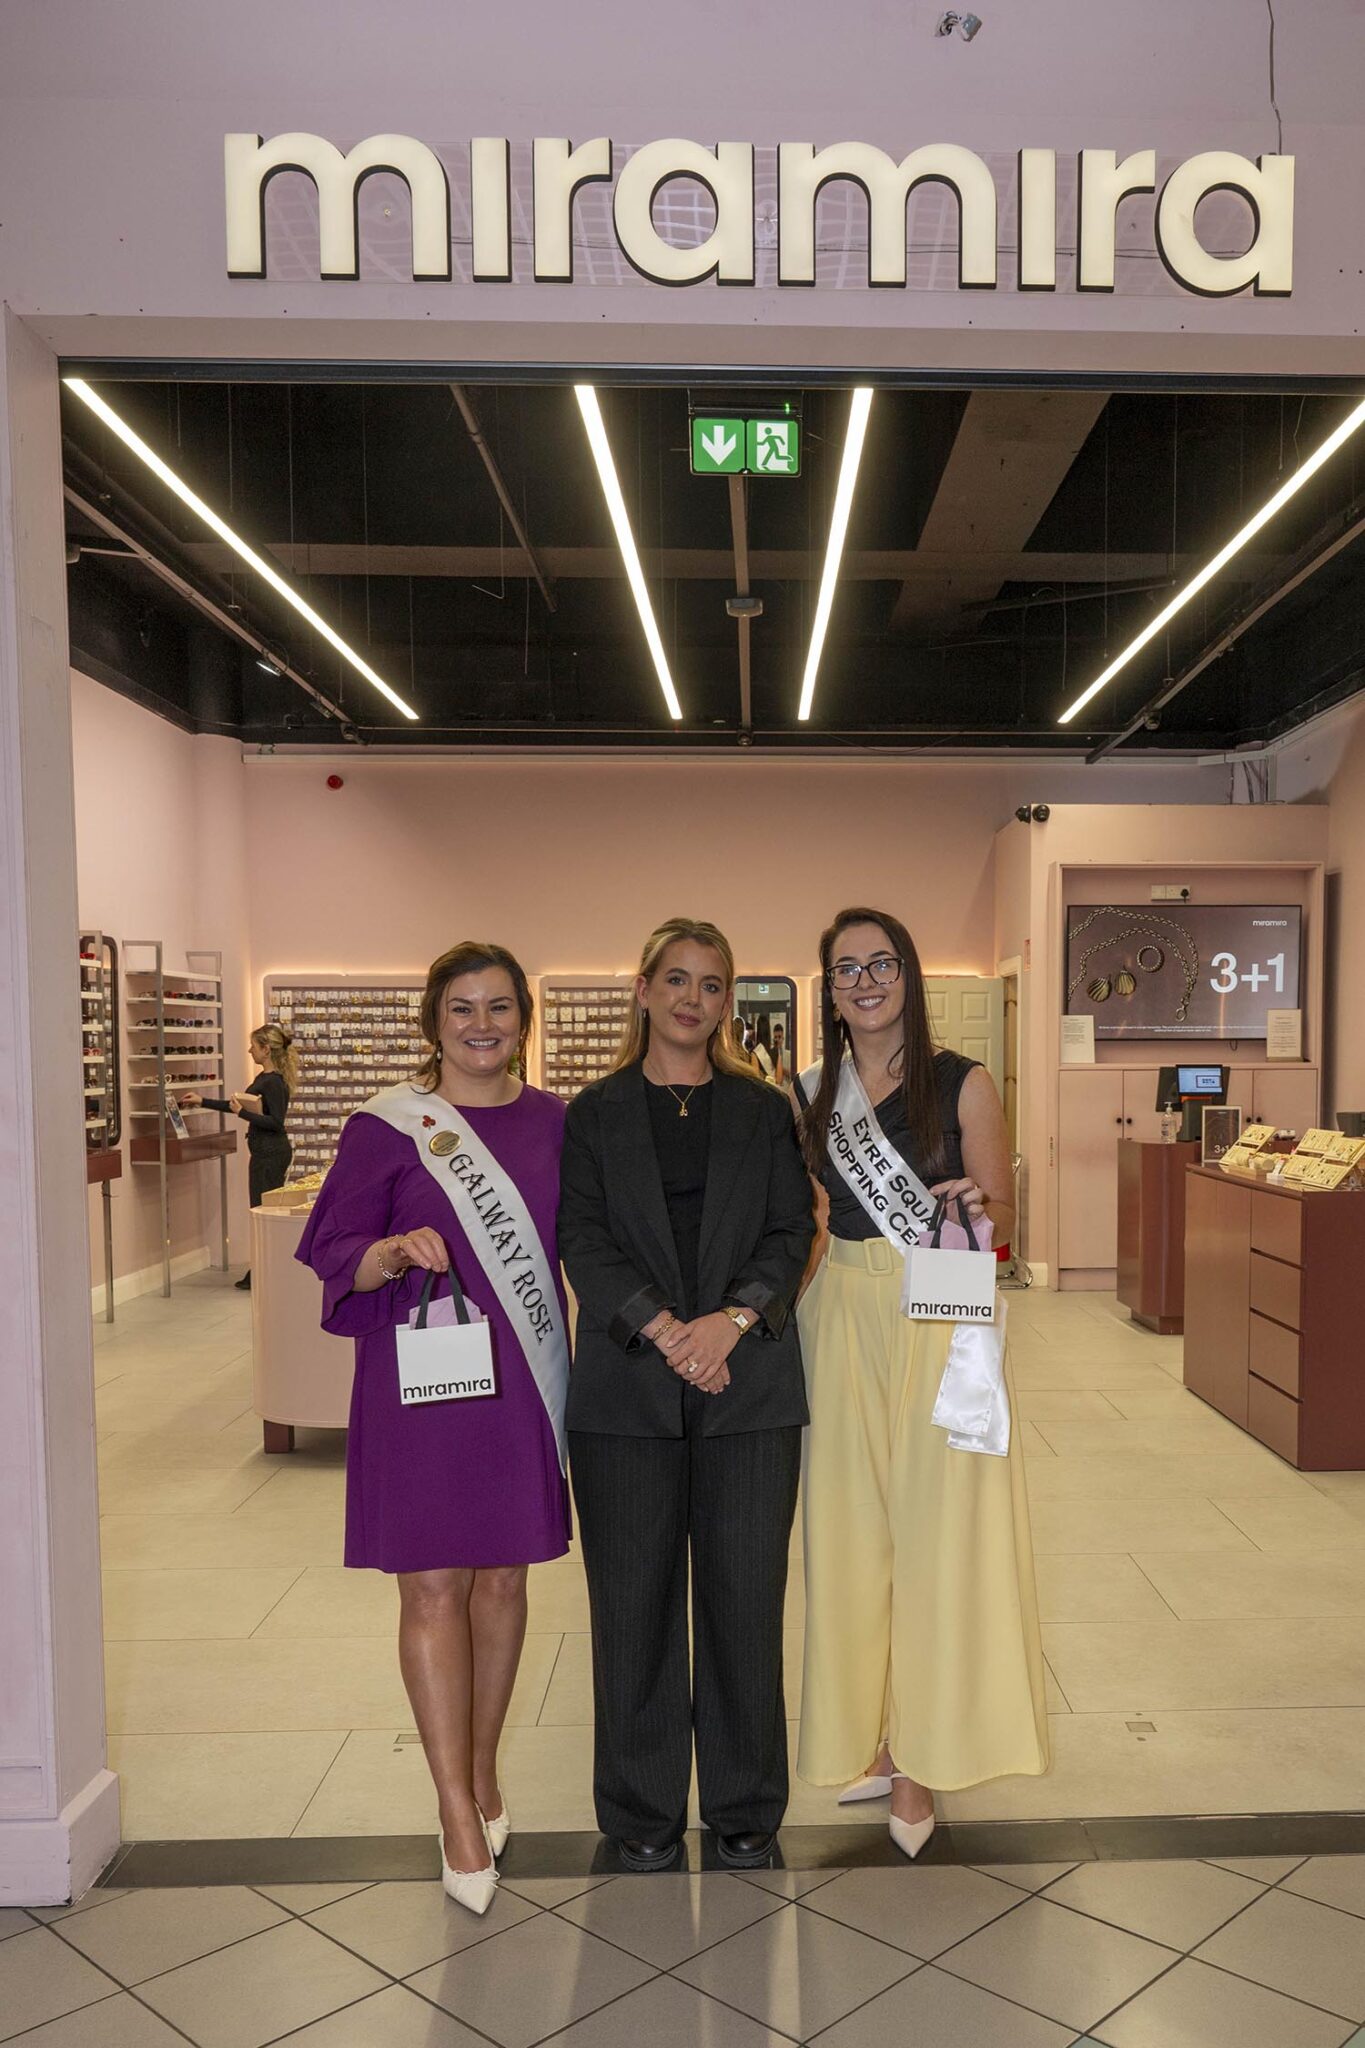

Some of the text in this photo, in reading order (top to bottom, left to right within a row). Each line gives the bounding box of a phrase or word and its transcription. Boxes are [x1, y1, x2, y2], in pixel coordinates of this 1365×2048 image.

[223, 132, 1295, 297] miramira
[1210, 952, 1285, 993] 3+1
[853, 1116, 893, 1176] EYRE
[829, 1111, 920, 1246] SHOPPING CE
[448, 1153, 554, 1345] GALWAY ROSE
[911, 1300, 993, 1318] miramira
[403, 1377, 492, 1400] miramira
